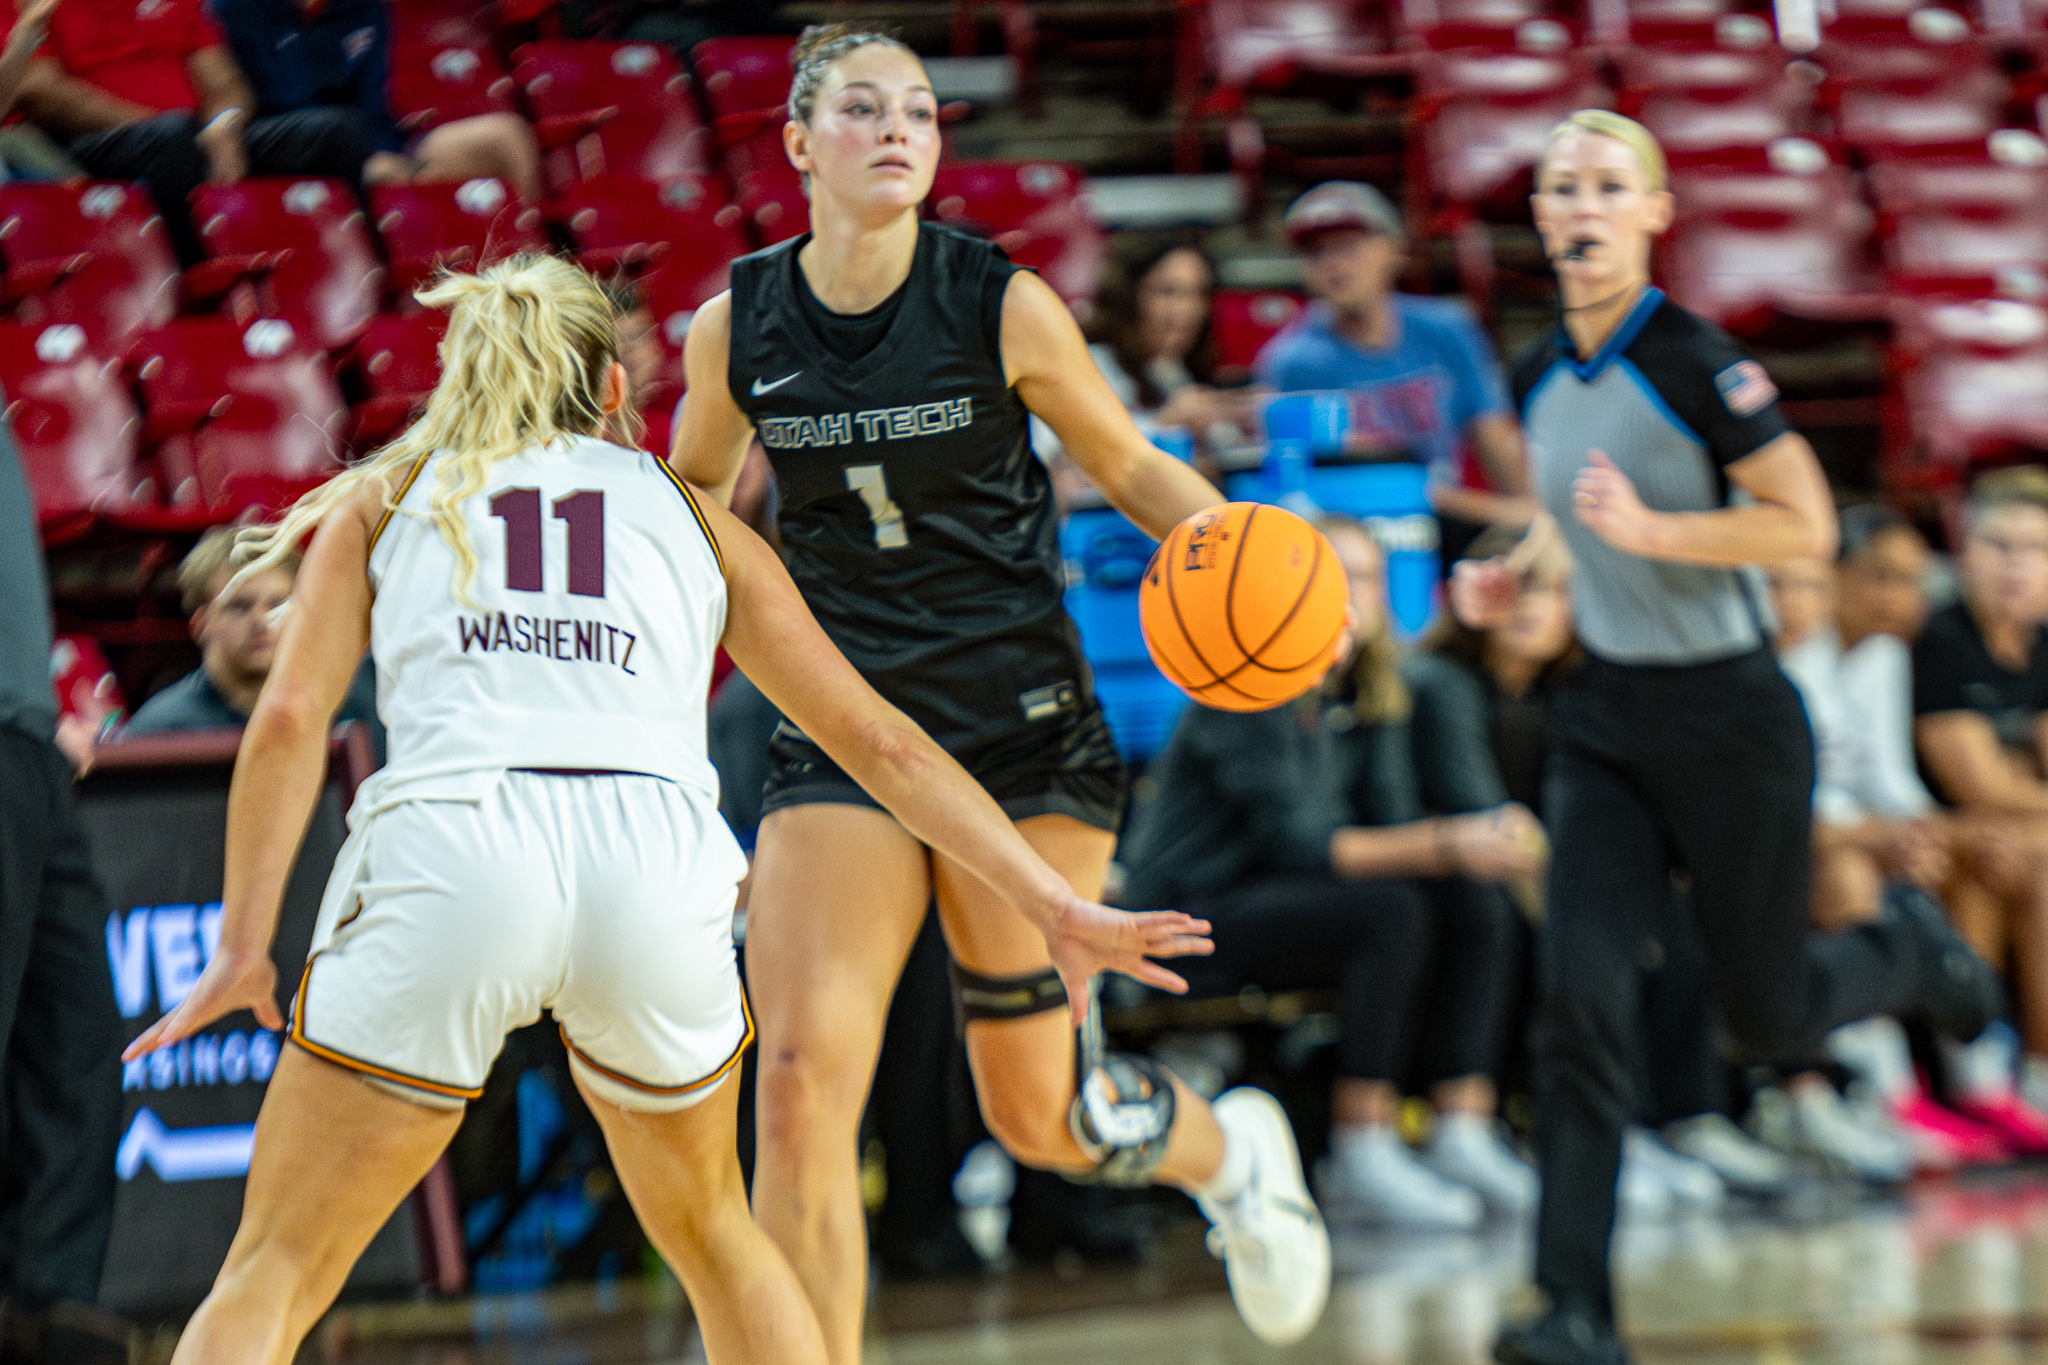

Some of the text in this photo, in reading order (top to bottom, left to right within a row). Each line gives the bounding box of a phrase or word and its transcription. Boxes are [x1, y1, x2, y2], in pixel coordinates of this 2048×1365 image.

[758, 397, 973, 449] UTAH TECH
[489, 485, 605, 599] 11
[845, 464, 909, 549] 1
[458, 610, 637, 676] WASHENITZ
